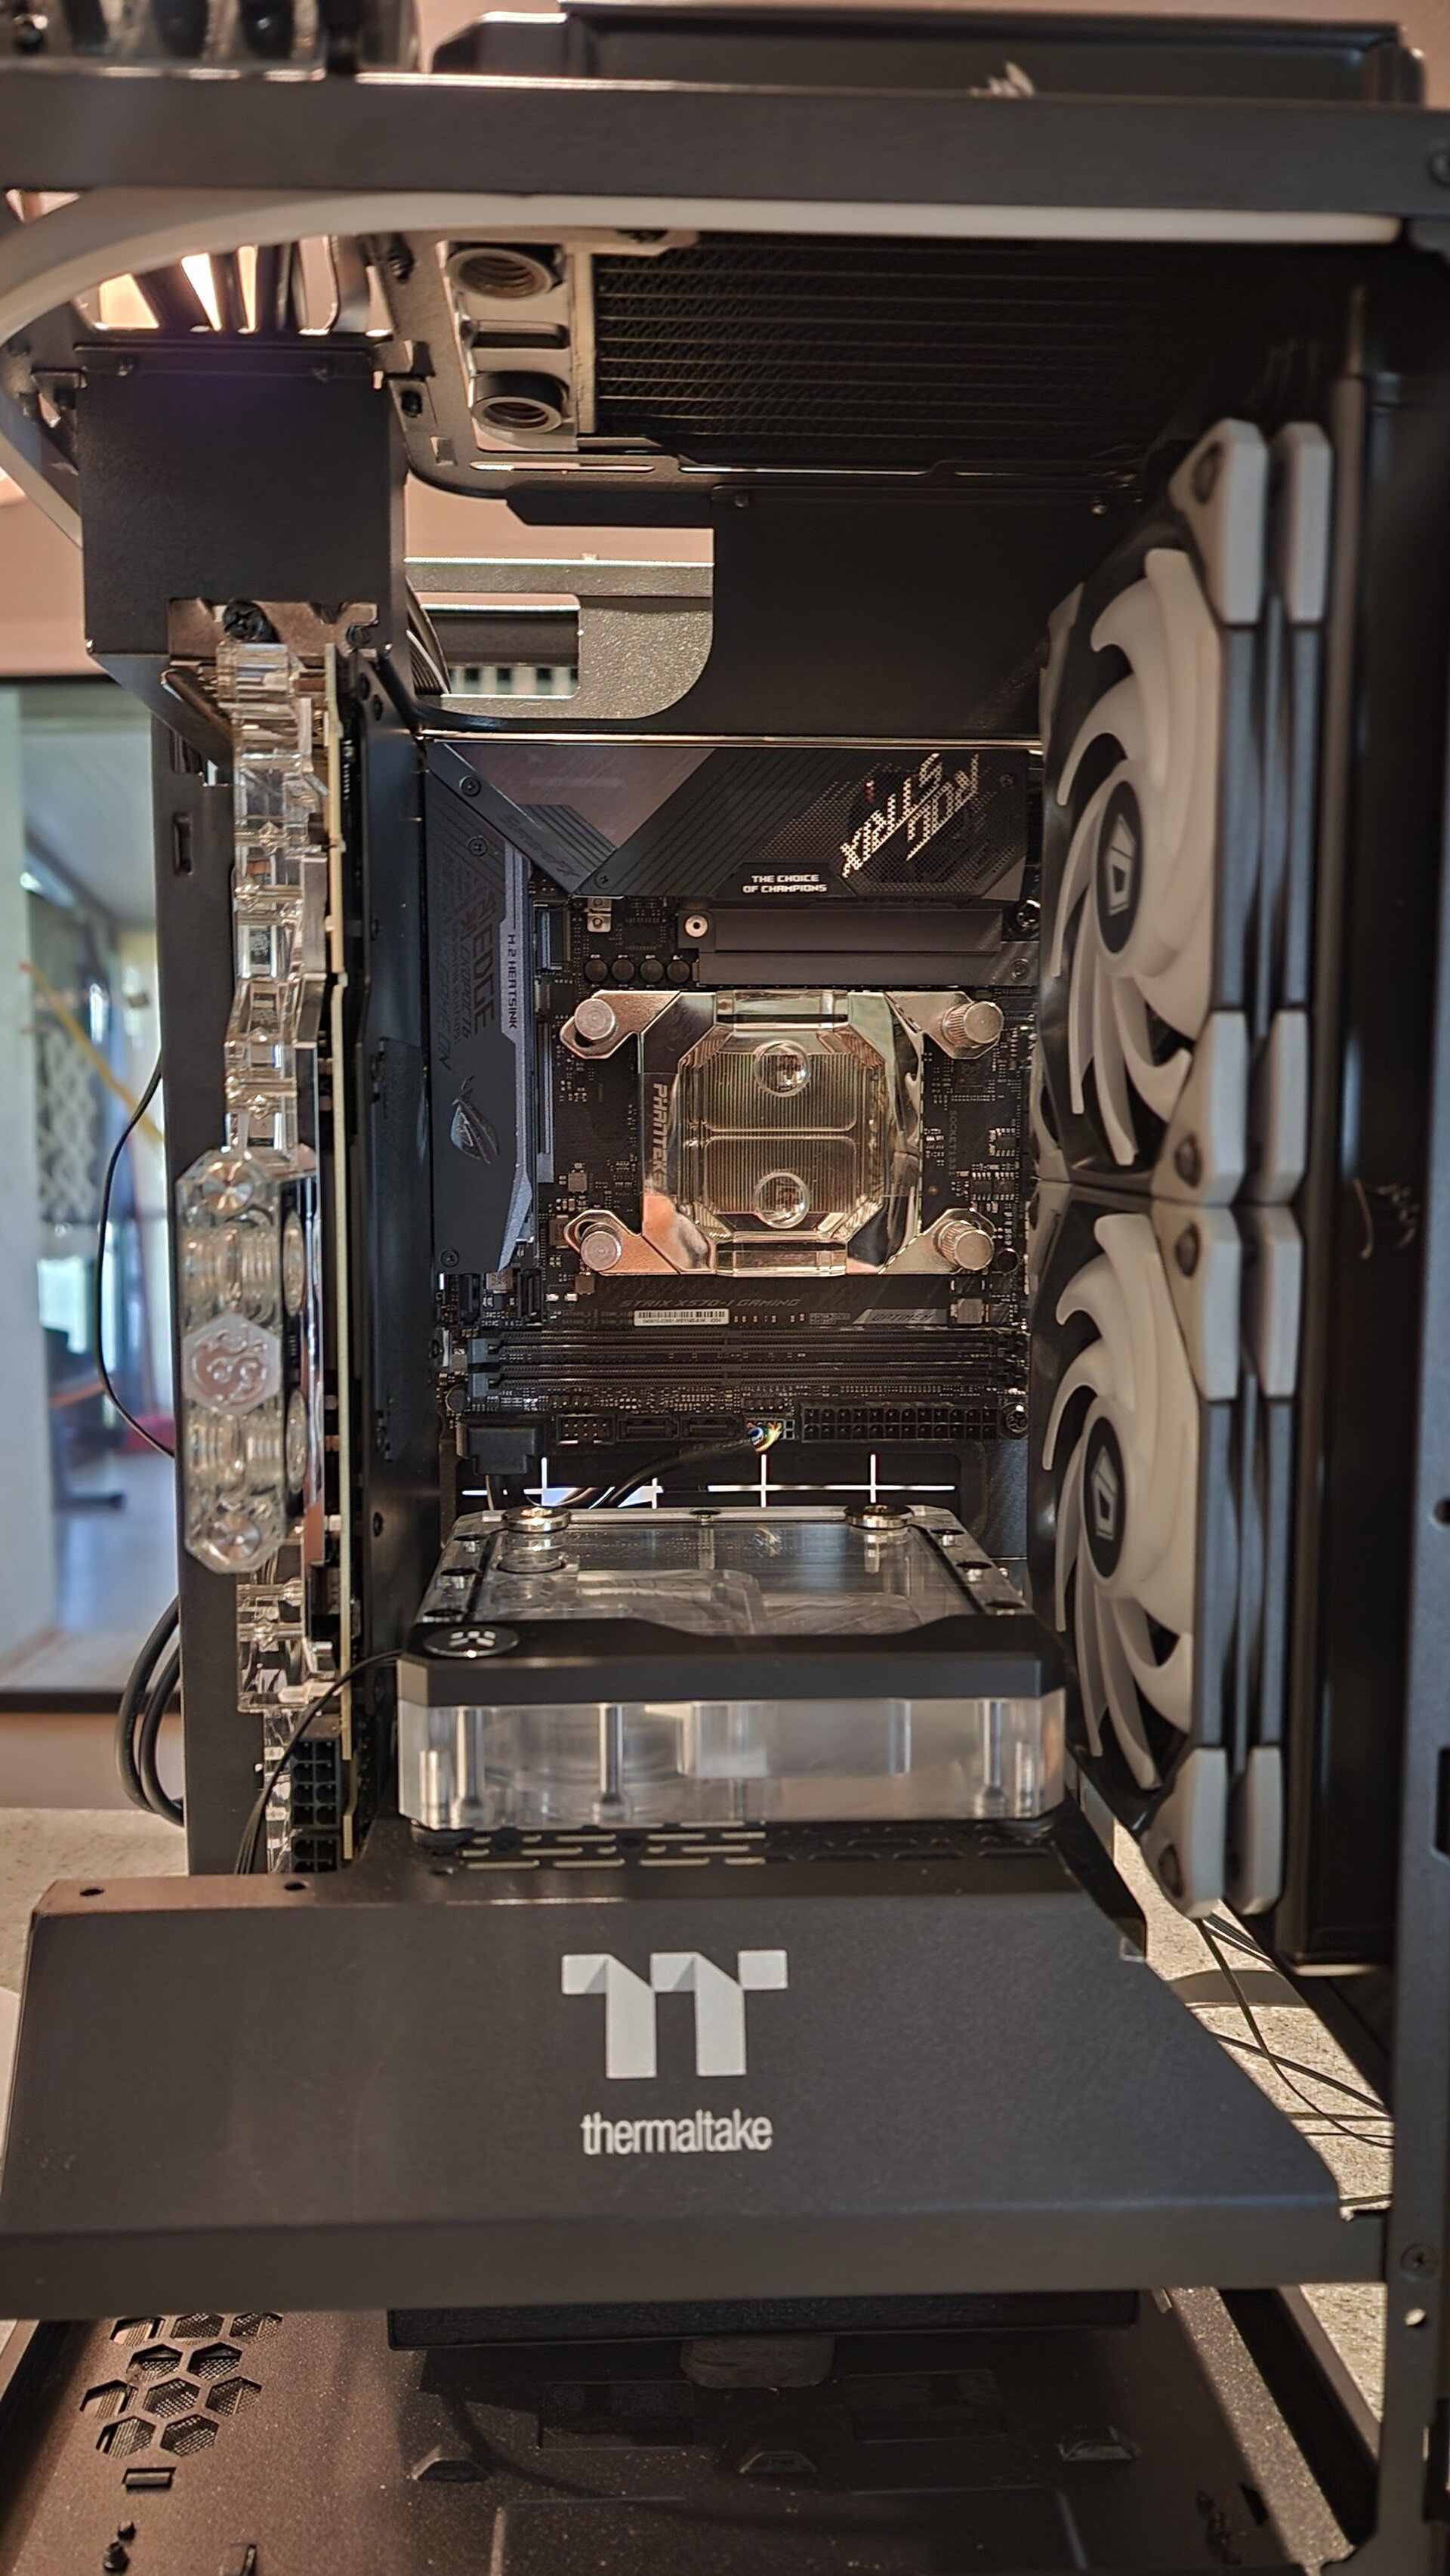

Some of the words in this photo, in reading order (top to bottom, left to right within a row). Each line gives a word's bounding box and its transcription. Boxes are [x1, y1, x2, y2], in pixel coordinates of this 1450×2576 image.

[838, 752, 942, 879] STRIX
[742, 885, 760, 894] OF
[760, 884, 828, 894] CHAMPIONS
[751, 875, 776, 884] THE
[776, 874, 820, 883] CHOICE
[508, 934, 517, 958] M.2
[474, 923, 495, 1036] EDGE
[507, 960, 517, 1029] HEATSINK
[619, 1299, 673, 1308] STRIX
[736, 1298, 802, 1307] GAMING
[580, 2108, 774, 2155] thermaltake
